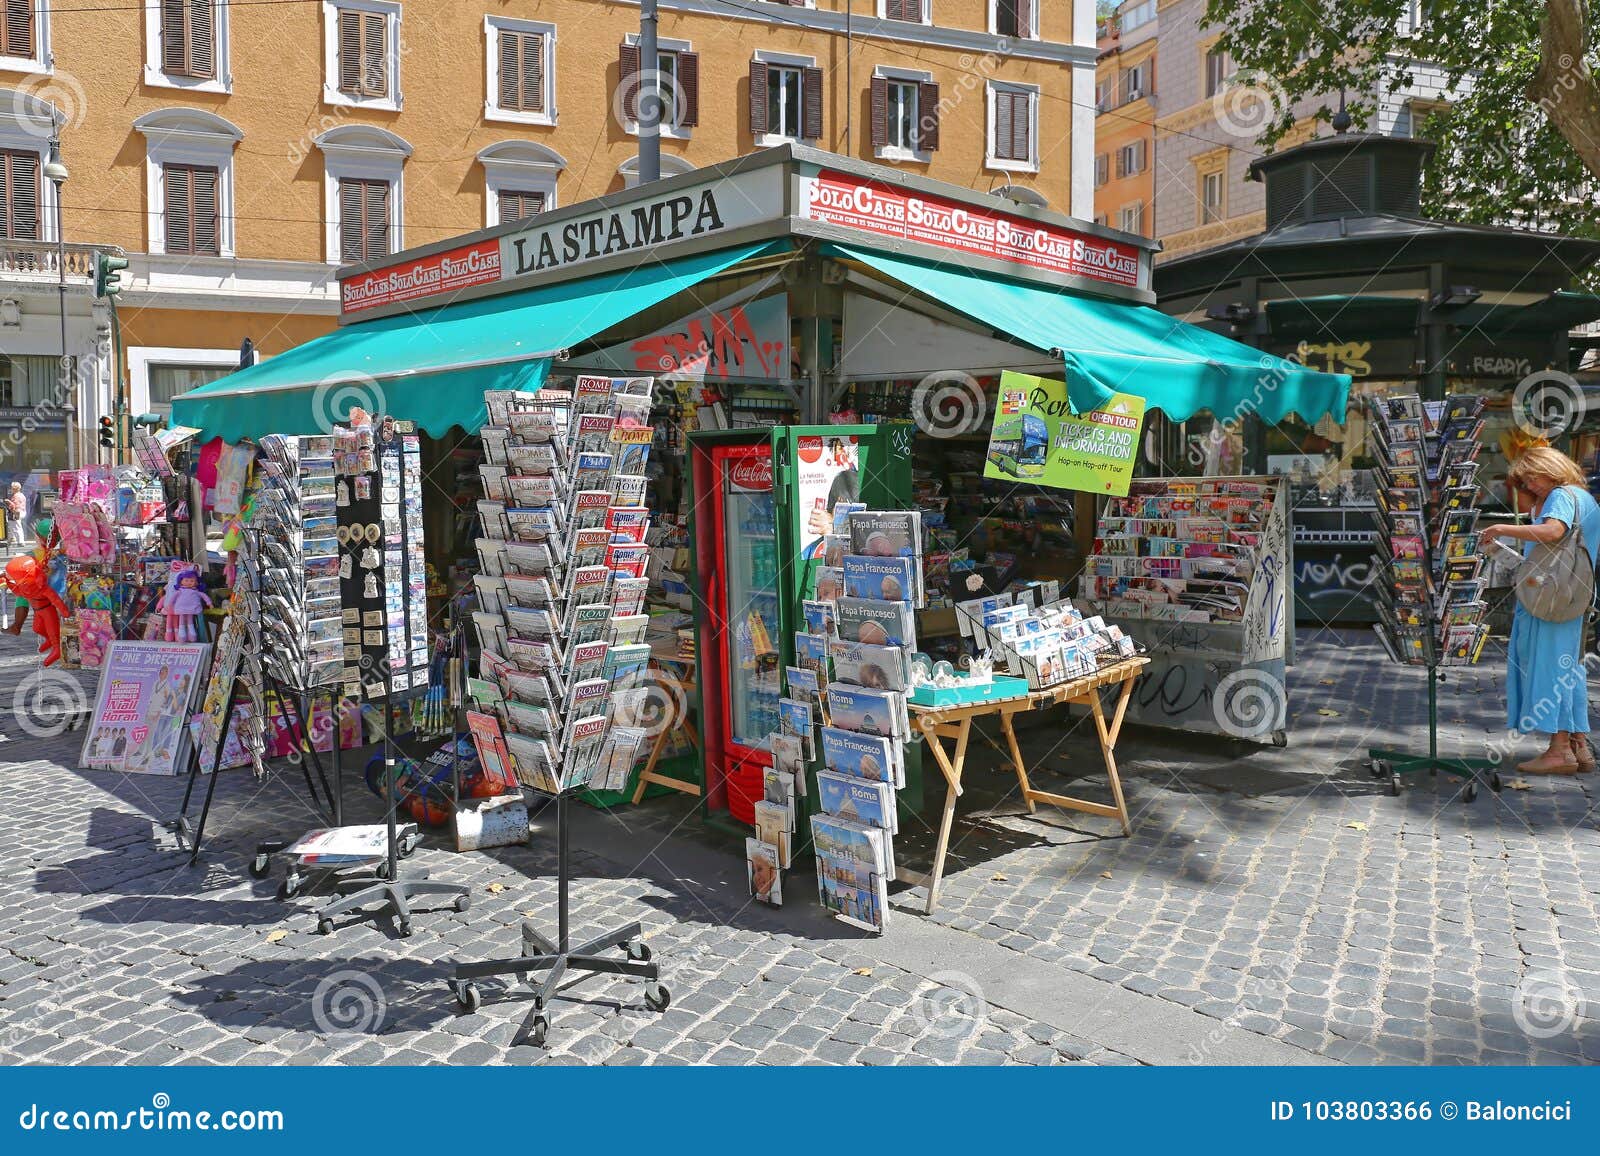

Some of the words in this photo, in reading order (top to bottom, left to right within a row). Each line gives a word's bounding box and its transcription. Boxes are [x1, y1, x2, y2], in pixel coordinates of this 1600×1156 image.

[1091, 412, 1115, 425] OPEN
[1114, 416, 1137, 430] TOUR
[1059, 422, 1106, 440] TICKETS
[1105, 430, 1132, 446] AND
[1054, 435, 1132, 458] INFORMATION
[1109, 464, 1124, 473] Tour
[852, 519, 871, 530] Papa
[871, 519, 909, 529] Francesco
[846, 562, 865, 574] Papa
[865, 563, 902, 574] Francesco
[840, 604, 859, 615] Papa
[859, 606, 896, 619] Francesco
[121, 652, 141, 664] ONE
[144, 654, 197, 666] DIRECTION
[836, 649, 862, 661] Angeli
[829, 691, 854, 705] Roma
[102, 713, 139, 722] Horan
[826, 735, 843, 749] Papa
[843, 738, 881, 755] Francesco
[851, 786, 878, 801] Roma
